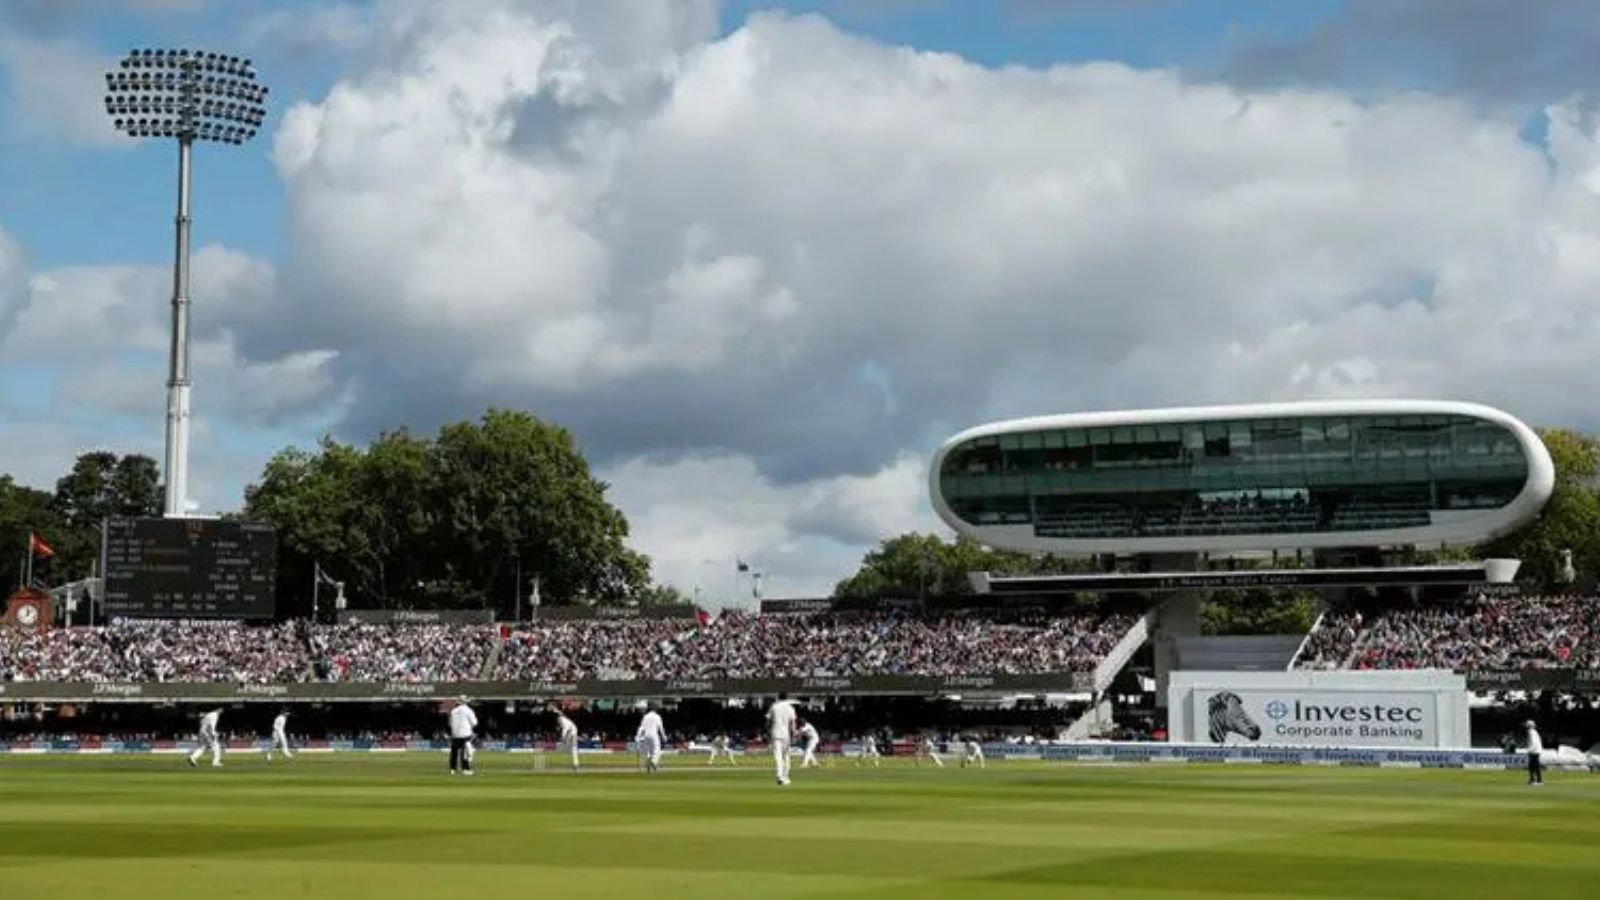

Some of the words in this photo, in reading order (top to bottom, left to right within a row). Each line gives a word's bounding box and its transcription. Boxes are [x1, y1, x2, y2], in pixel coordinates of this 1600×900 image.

[1295, 700, 1423, 722] Investec
[1276, 724, 1354, 737] Corporate
[1360, 725, 1423, 739] Banking
